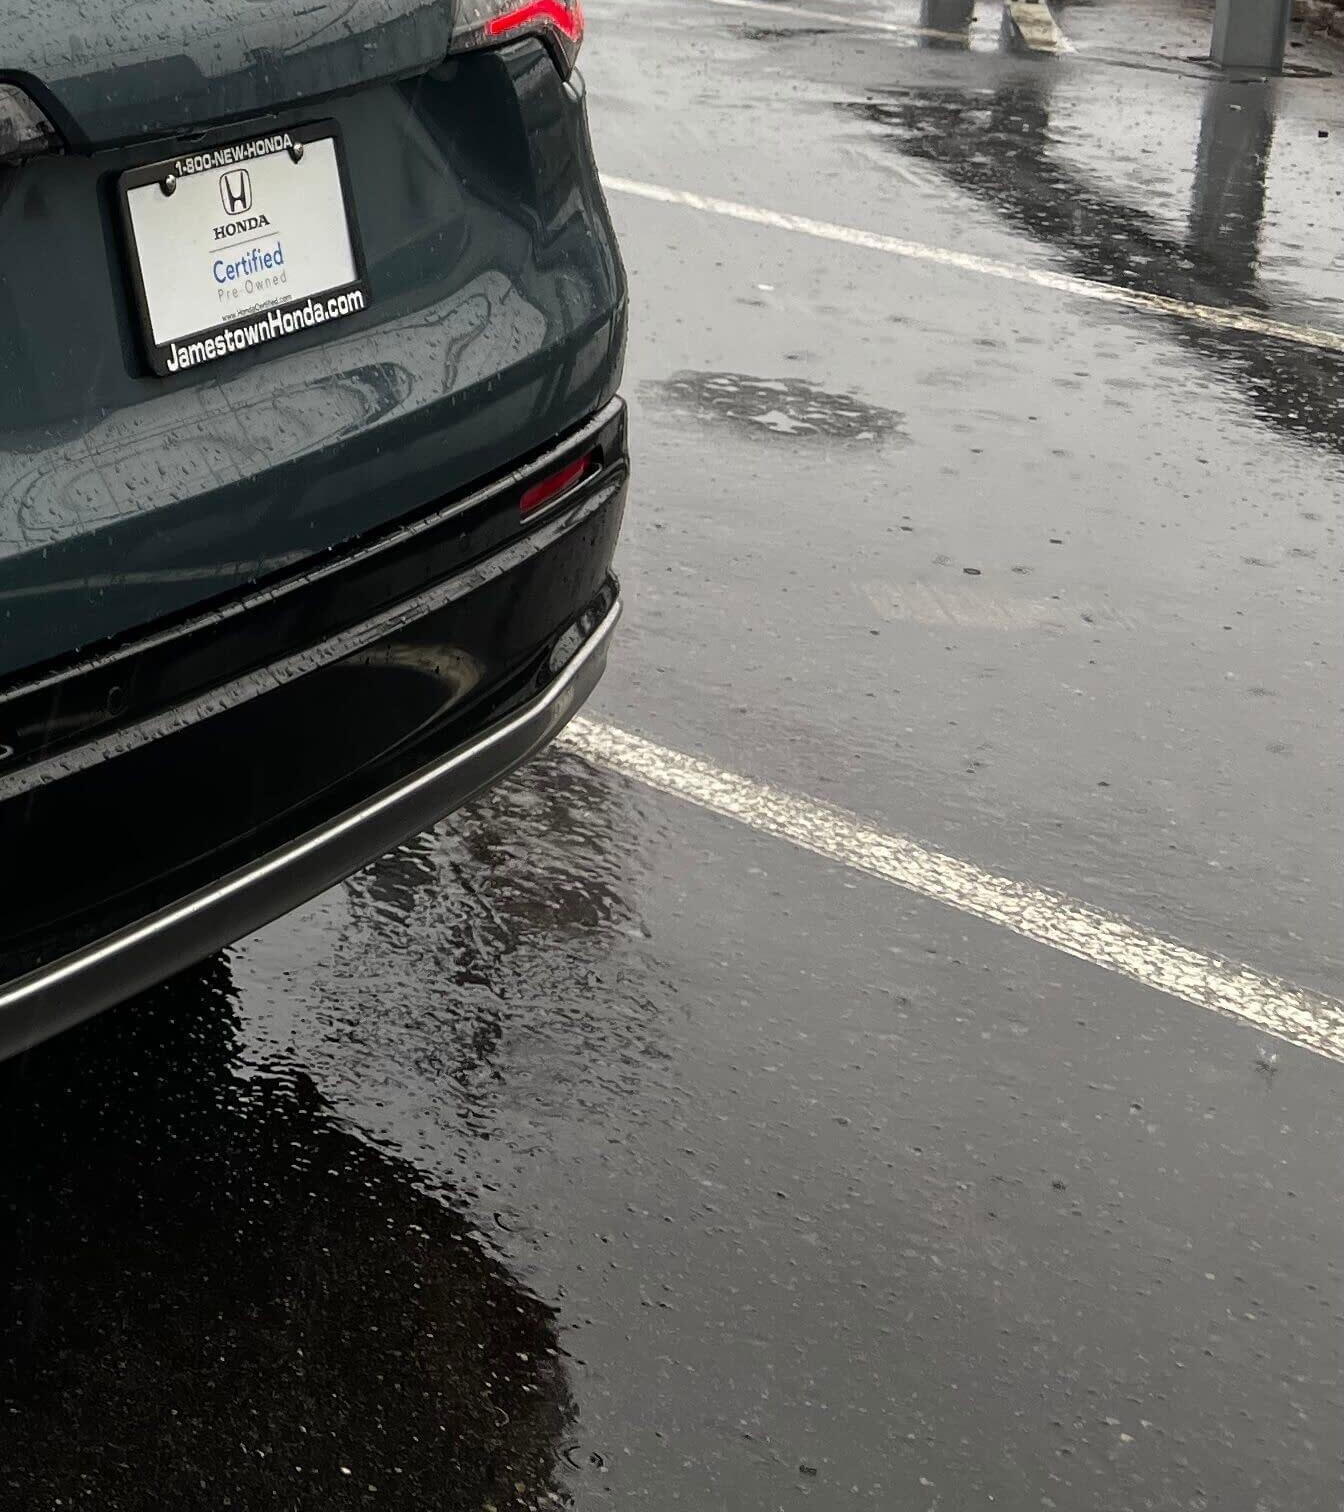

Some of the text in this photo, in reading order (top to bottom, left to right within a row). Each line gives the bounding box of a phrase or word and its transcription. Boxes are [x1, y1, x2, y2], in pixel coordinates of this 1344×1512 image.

[175, 133, 293, 176] 1-800-NEW-HONDA
[212, 214, 270, 240] HONDA
[213, 240, 284, 283] Certified
[166, 289, 365, 372] JamestownHonda.com
